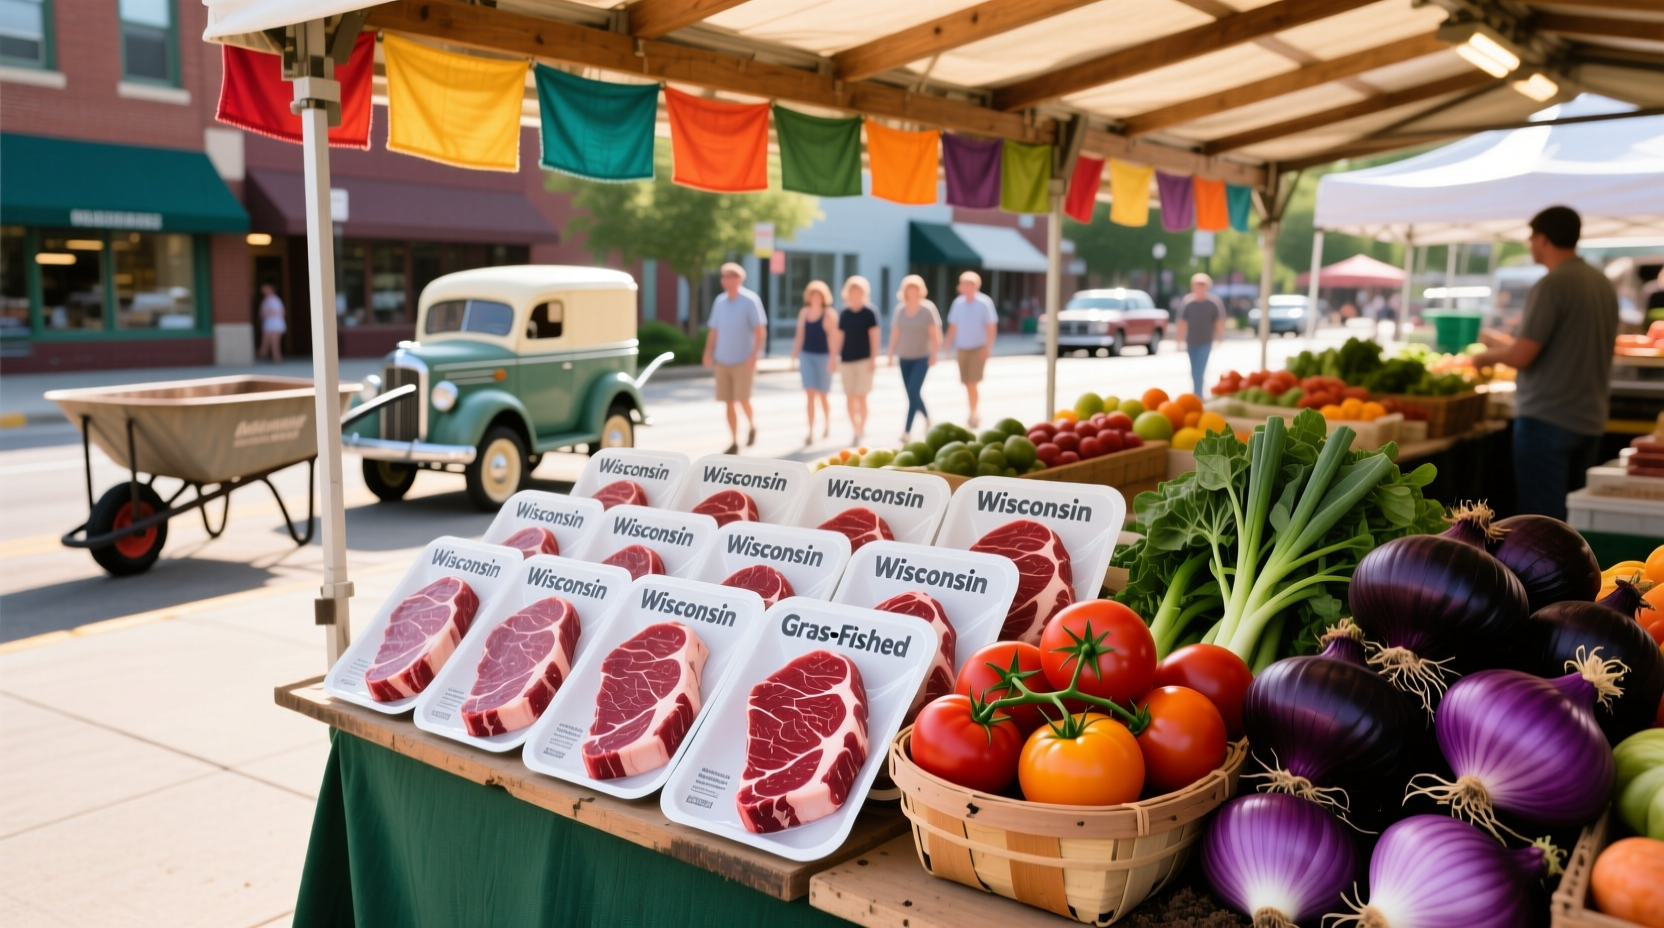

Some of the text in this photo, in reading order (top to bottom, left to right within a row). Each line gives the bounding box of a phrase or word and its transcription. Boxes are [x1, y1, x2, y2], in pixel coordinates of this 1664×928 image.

[600, 458, 669, 480] Wisconsin
[704, 466, 787, 491] Wisconsin
[828, 479, 924, 508] Wisconsin
[978, 491, 1091, 522] Wisconsin
[517, 502, 584, 528] Wisconsin
[614, 517, 693, 546] Wisconsin
[728, 535, 823, 567] Wisconsin
[528, 567, 607, 599] Wisconsin
[876, 556, 987, 594] Wisconsin
[642, 589, 736, 627] Wisconsin
[782, 614, 911, 657] Gras-Fished
